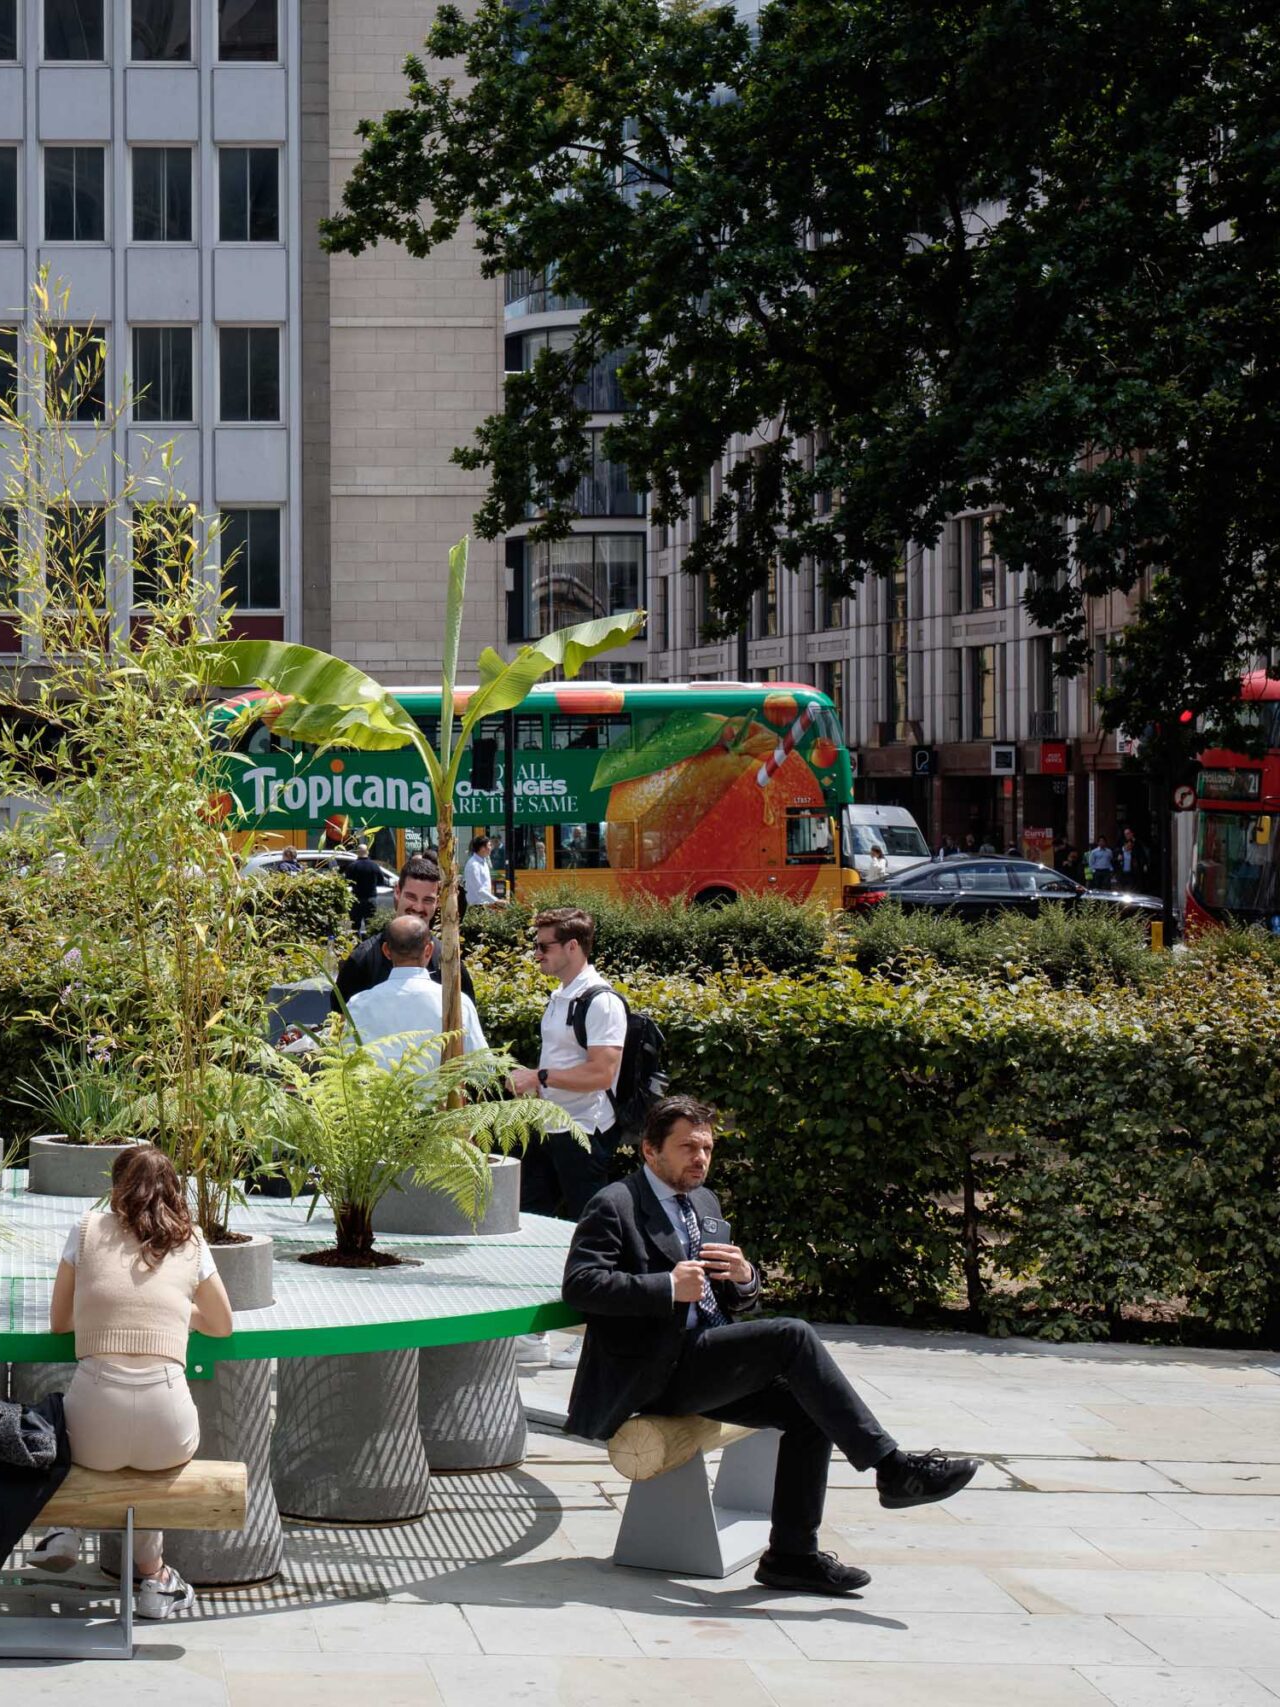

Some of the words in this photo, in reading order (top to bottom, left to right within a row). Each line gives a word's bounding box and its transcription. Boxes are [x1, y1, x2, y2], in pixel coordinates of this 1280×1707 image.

[517, 763, 551, 779] ALL
[242, 758, 432, 819] Tropicana
[528, 796, 578, 812] SAME
